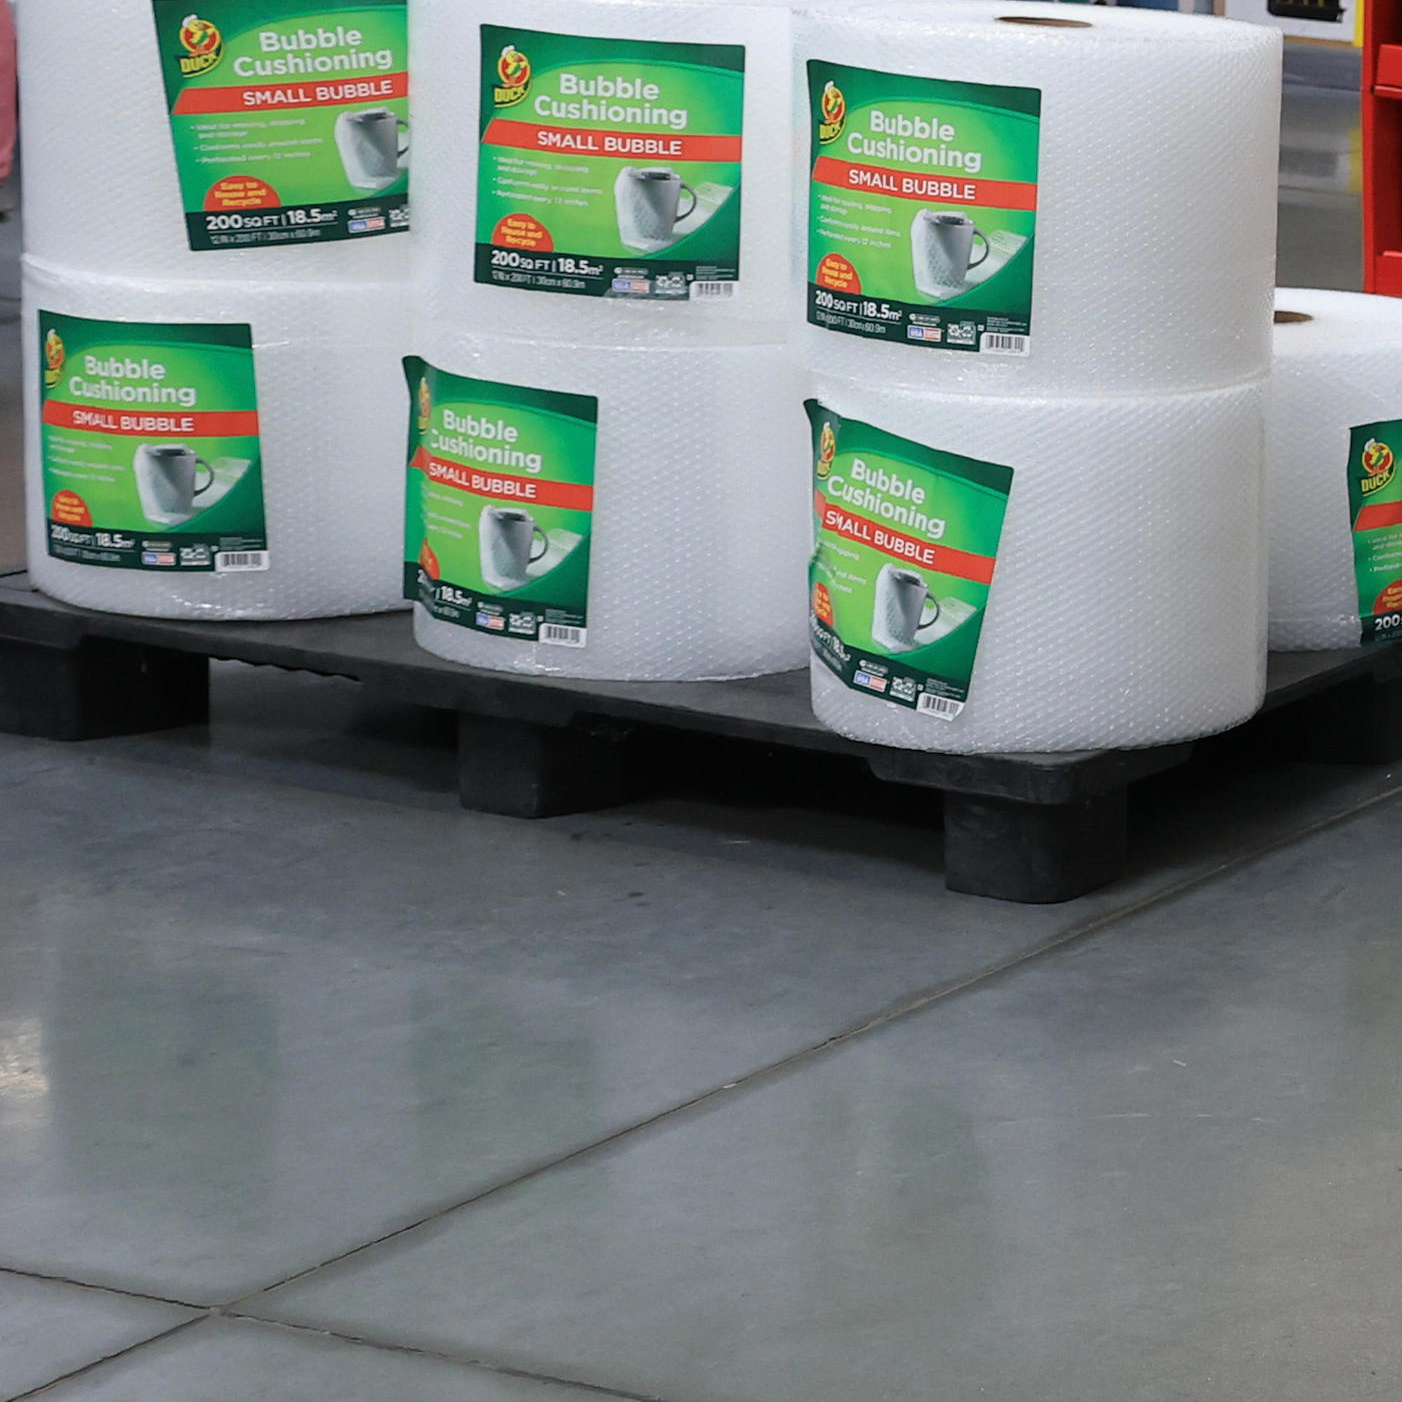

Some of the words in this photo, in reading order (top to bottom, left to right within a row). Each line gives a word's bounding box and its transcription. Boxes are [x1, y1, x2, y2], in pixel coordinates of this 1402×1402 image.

[258, 26, 363, 52] Bubble
[180, 53, 218, 74] DUCK
[233, 49, 394, 77] Cushioning
[242, 87, 312, 106] SMALL
[315, 80, 394, 99] BUBBLE
[559, 73, 660, 100] Bubble
[534, 95, 688, 130] Cushioning
[870, 110, 955, 142] Bubble
[537, 130, 599, 151] SMALL
[604, 137, 682, 155] BUBBLE
[847, 132, 982, 174] Cushioning
[849, 169, 898, 192] SMALL
[902, 179, 976, 200] BUBBLE
[206, 214, 243, 230] 200
[244, 216, 262, 227] SQ
[263, 215, 279, 226] FT
[490, 249, 520, 268] 200
[520, 258, 534, 269] SQ
[535, 258, 551, 271] FT
[815, 289, 833, 309] 200
[833, 299, 847, 313] SQ
[847, 302, 858, 313] FT
[84, 355, 166, 380] Bubble
[69, 376, 197, 408] Cushioning
[72, 410, 118, 429] SMALL
[121, 416, 194, 432] BUBBLE
[442, 409, 519, 443] Bubble
[428, 462, 470, 487] SMALL
[471, 474, 537, 499] BUBBLE
[851, 458, 927, 506] Bubble
[1361, 470, 1391, 493] DUCK
[827, 475, 947, 540] Cushioning
[873, 528, 937, 566] BUBBLE
[1374, 613, 1400, 632] 200
